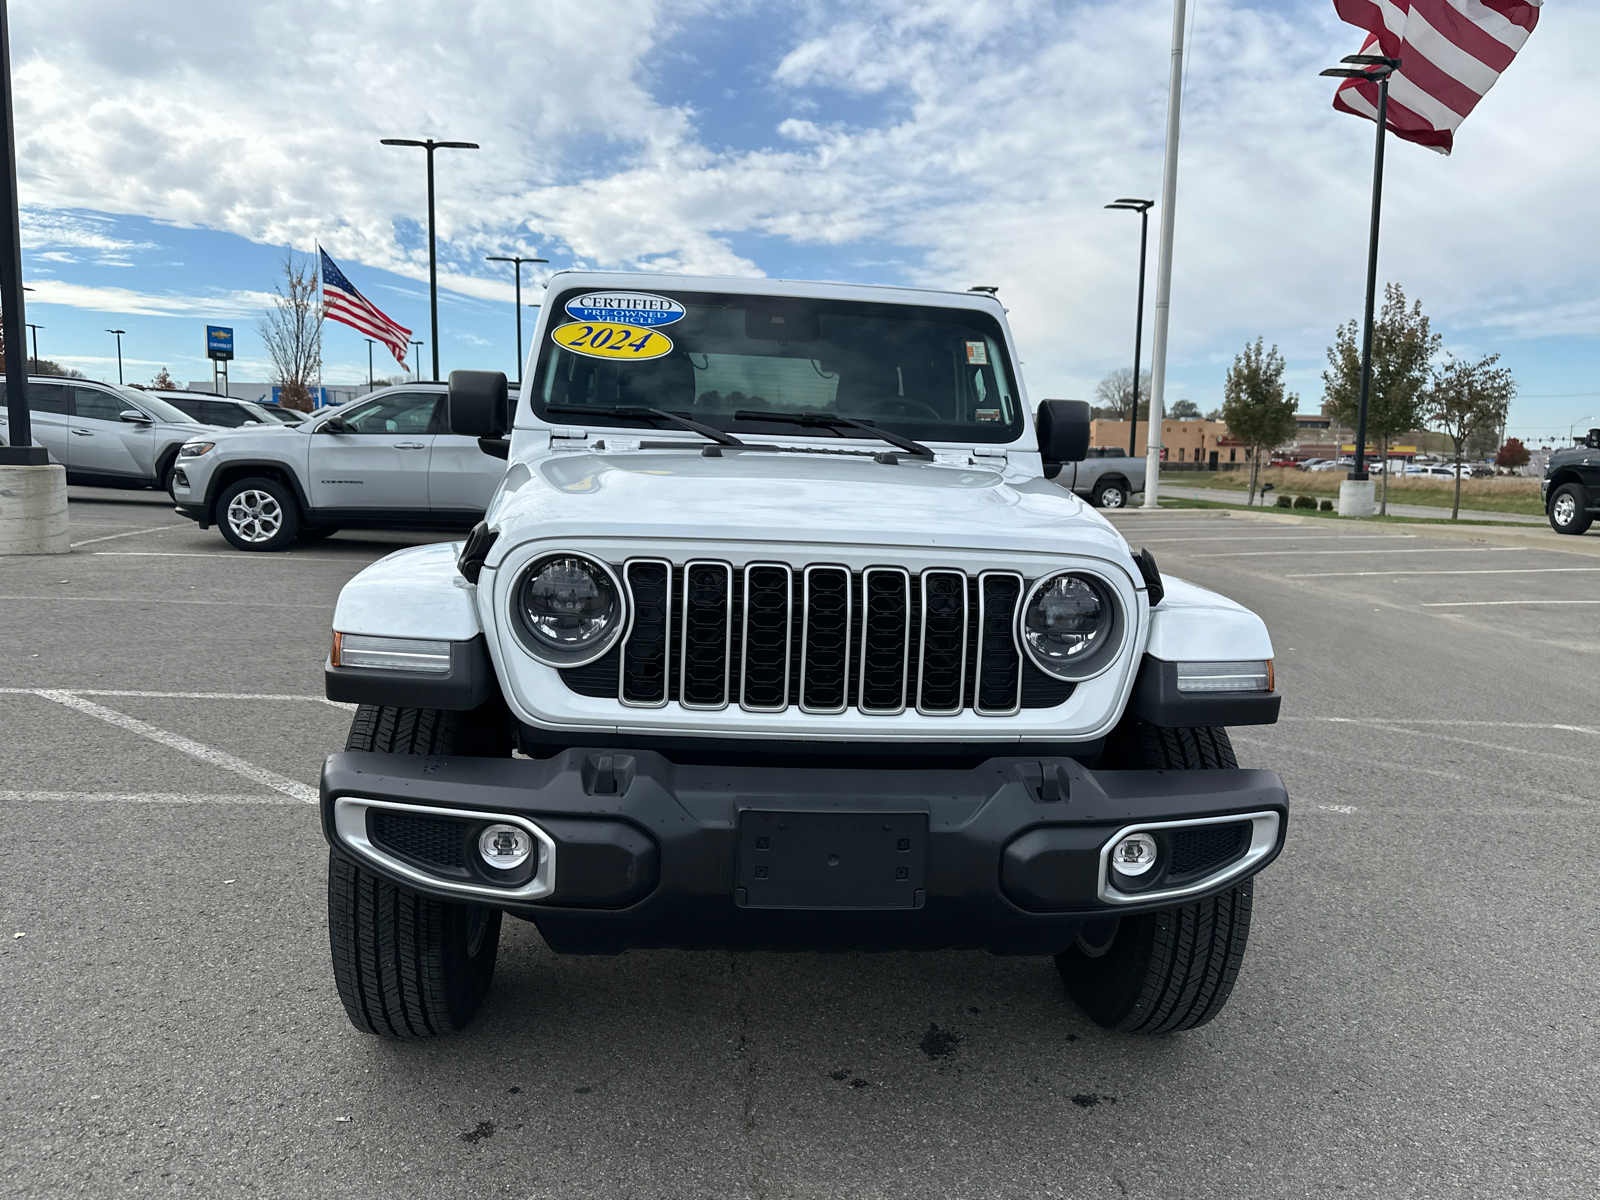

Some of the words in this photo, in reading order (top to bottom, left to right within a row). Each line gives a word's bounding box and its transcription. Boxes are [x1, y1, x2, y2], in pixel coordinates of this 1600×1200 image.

[580, 297, 672, 310] CERTIFIED
[584, 309, 667, 318] PRE-OWNED
[568, 326, 654, 352] 2024
